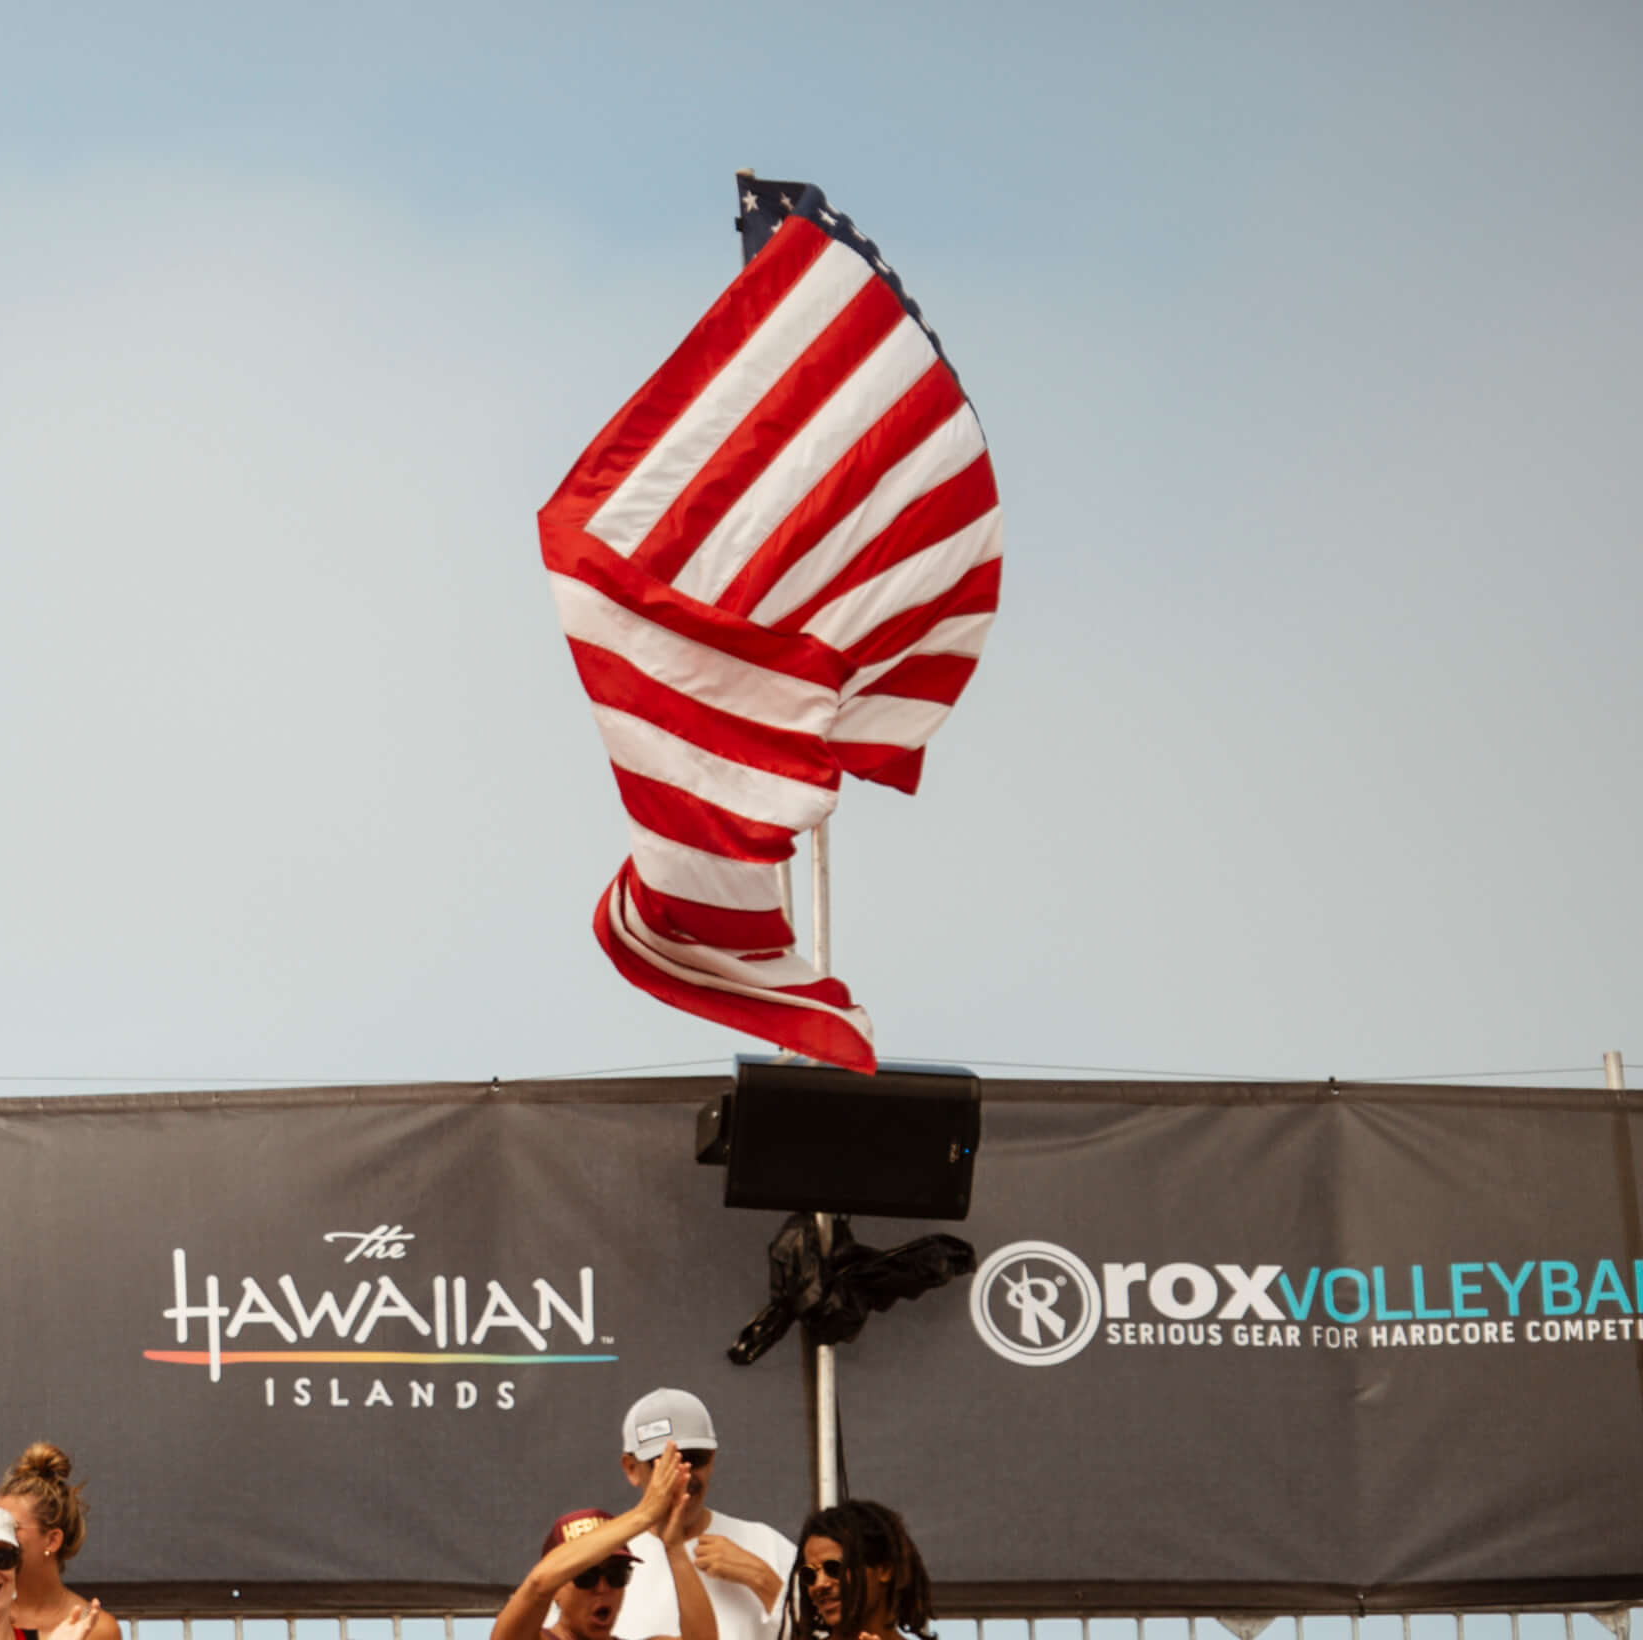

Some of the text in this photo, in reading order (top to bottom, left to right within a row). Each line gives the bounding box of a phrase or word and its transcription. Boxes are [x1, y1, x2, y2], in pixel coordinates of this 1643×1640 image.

[324, 1225, 415, 1264] The
[1103, 1258, 1643, 1323] roxVOLLEYBA
[163, 1247, 595, 1383] HAWAIIAN
[1107, 1322, 1223, 1346] SERIOUS
[1233, 1324, 1301, 1347] GEAR
[1313, 1325, 1359, 1349] FOR
[1371, 1320, 1515, 1348] HARDCORE
[265, 1376, 515, 1410] ISLANDS
